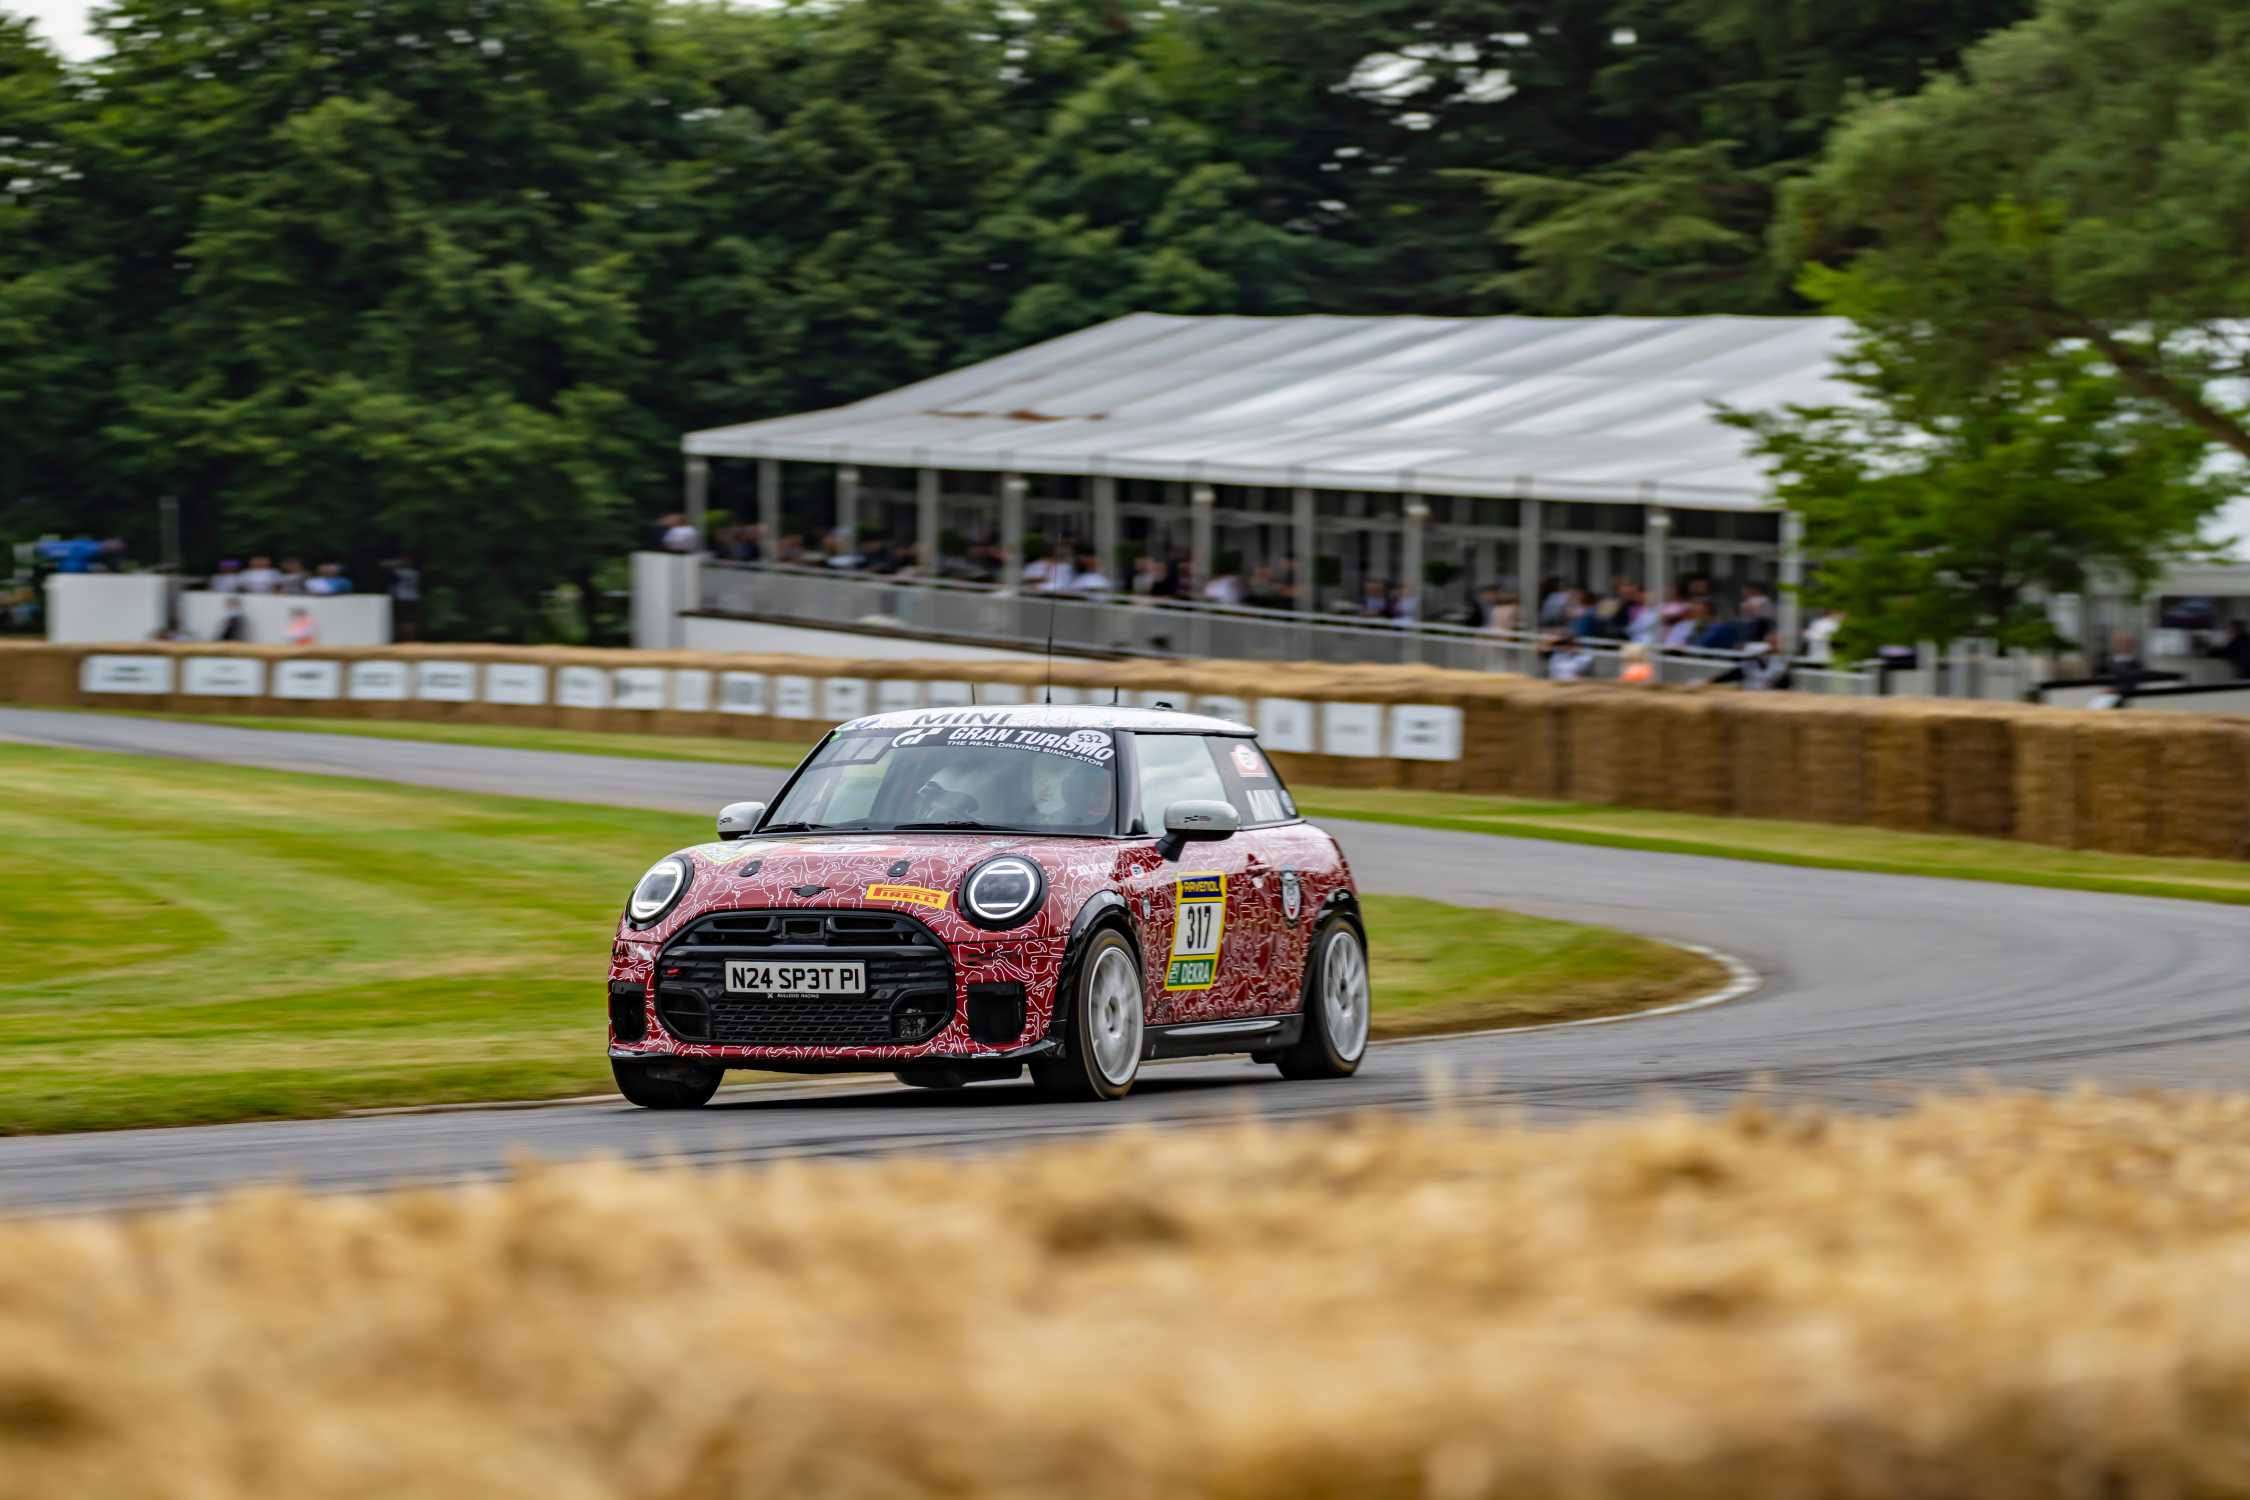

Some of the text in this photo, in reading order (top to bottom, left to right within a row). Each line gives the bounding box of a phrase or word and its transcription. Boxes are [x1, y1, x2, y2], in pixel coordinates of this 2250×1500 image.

[911, 713, 1013, 727] MINI
[949, 727, 1115, 761] GRAN TURISMO
[1078, 734, 1102, 744] 532
[998, 742, 1041, 752] DRIVING
[1043, 748, 1104, 768] SIMULATOR
[873, 886, 939, 905] PIRELLI
[1186, 905, 1212, 949] 317
[732, 967, 773, 989] N24
[778, 968, 834, 990] SP3T
[1181, 962, 1210, 984] DEKRA
